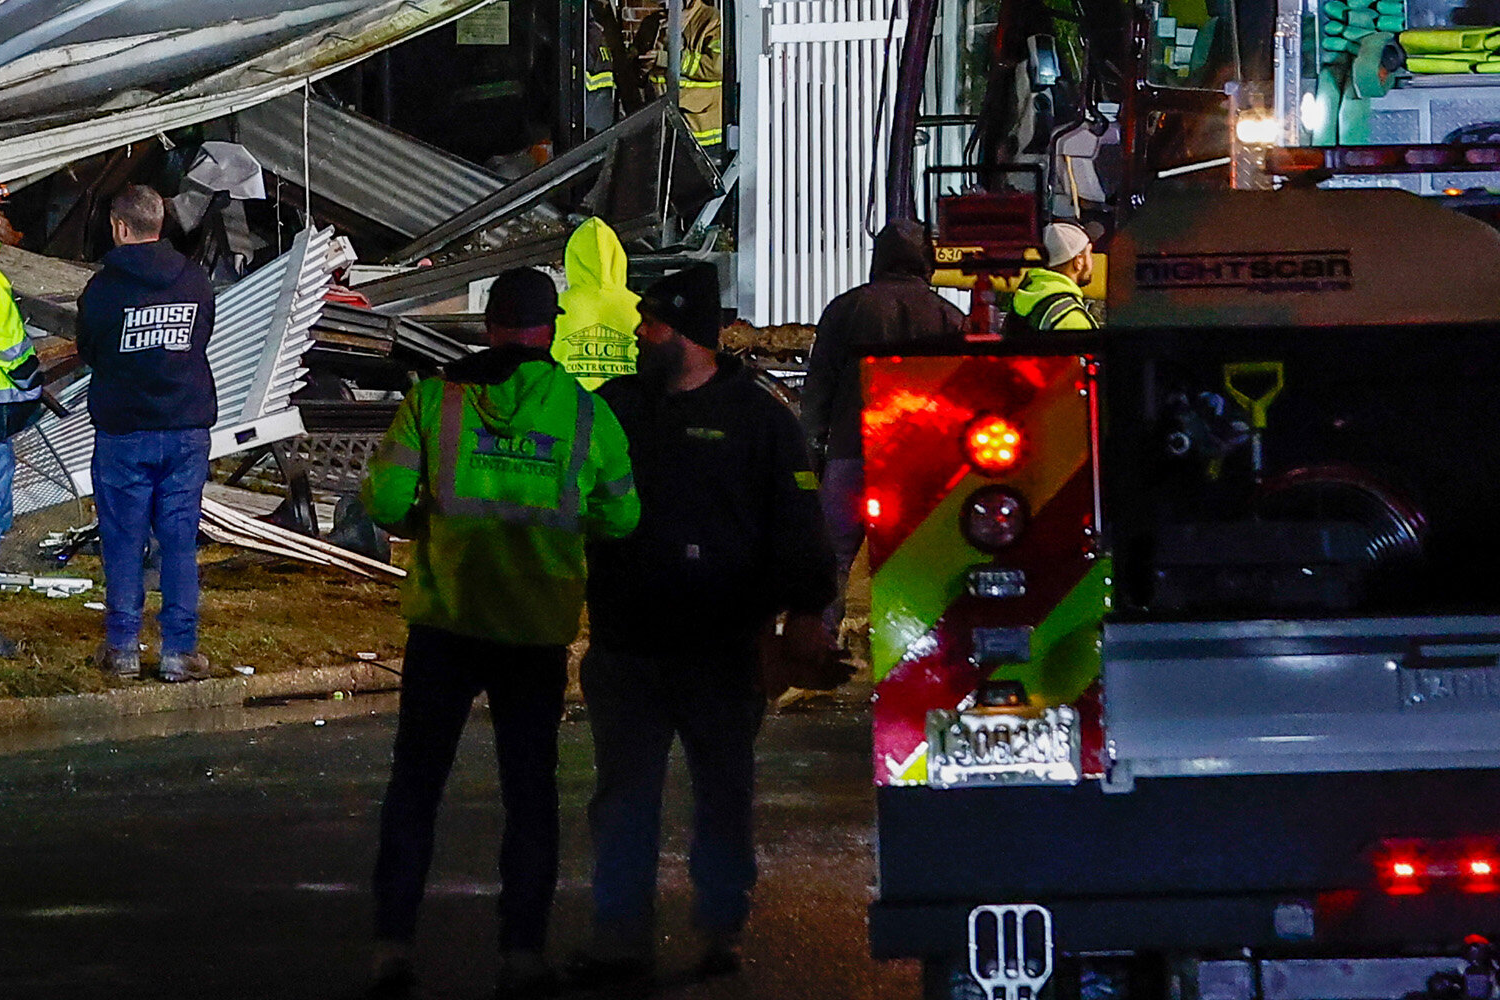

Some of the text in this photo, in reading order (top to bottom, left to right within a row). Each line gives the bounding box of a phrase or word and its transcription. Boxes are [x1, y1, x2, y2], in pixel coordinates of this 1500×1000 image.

[126, 306, 194, 328] HOUSE
[124, 328, 190, 349] CHAOS
[584, 342, 615, 357] CLC
[566, 362, 636, 374] CONTRACTORS
